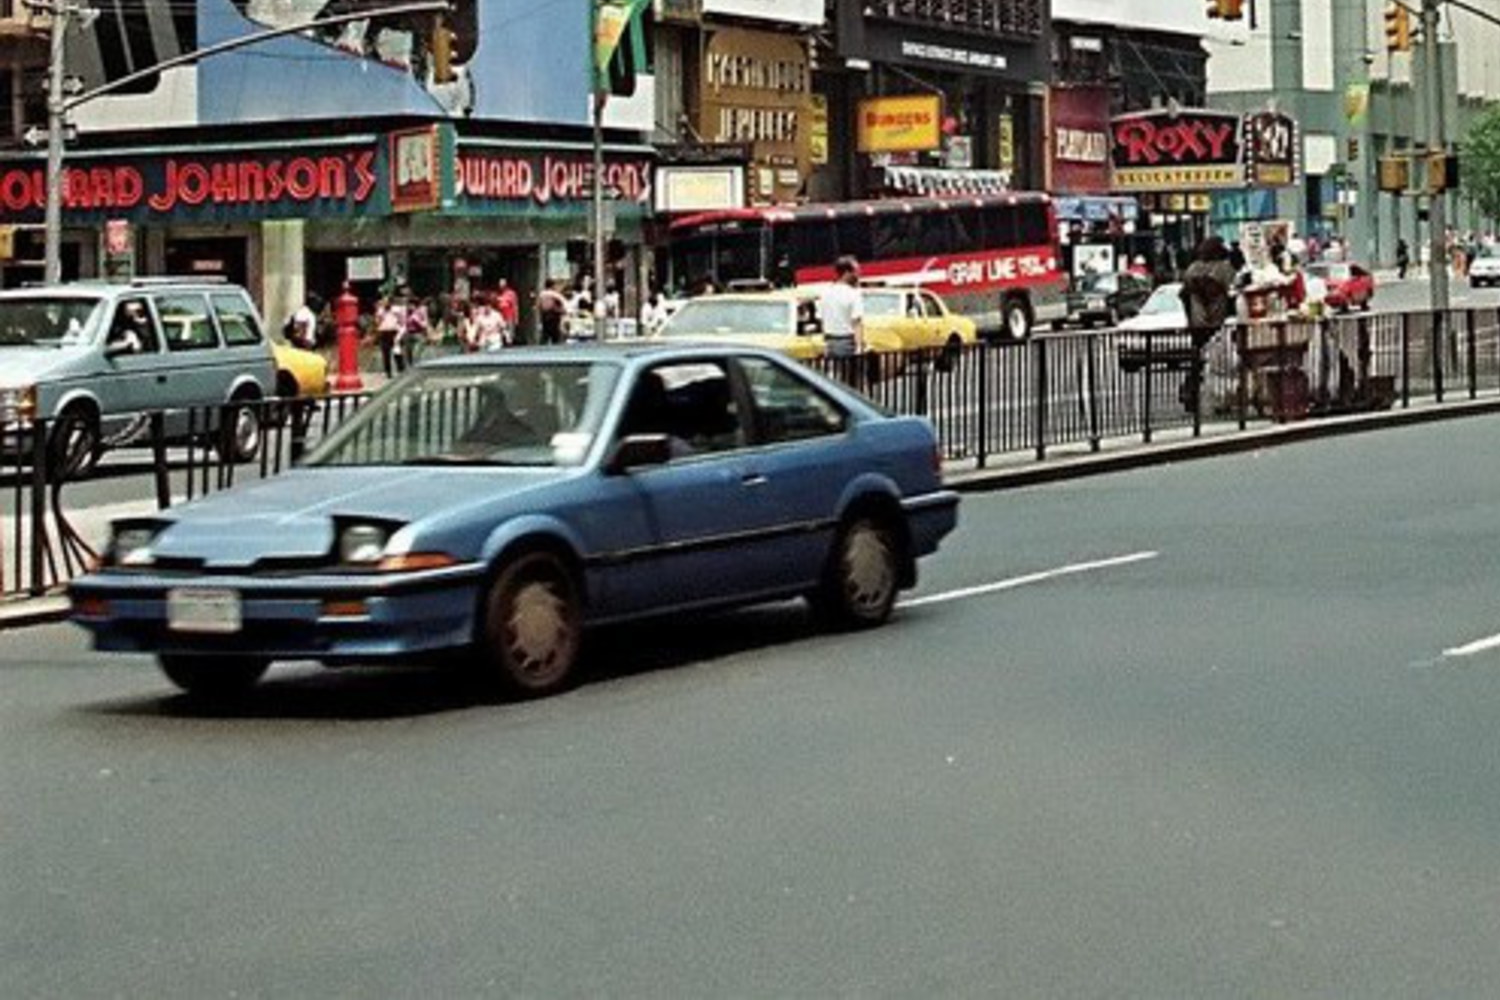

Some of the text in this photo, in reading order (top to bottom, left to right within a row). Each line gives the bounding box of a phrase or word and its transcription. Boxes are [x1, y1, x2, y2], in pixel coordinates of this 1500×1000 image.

[148, 150, 377, 211] JOHNSON'S
[949, 259, 984, 286] GRAY
[986, 256, 1017, 281] LINE
